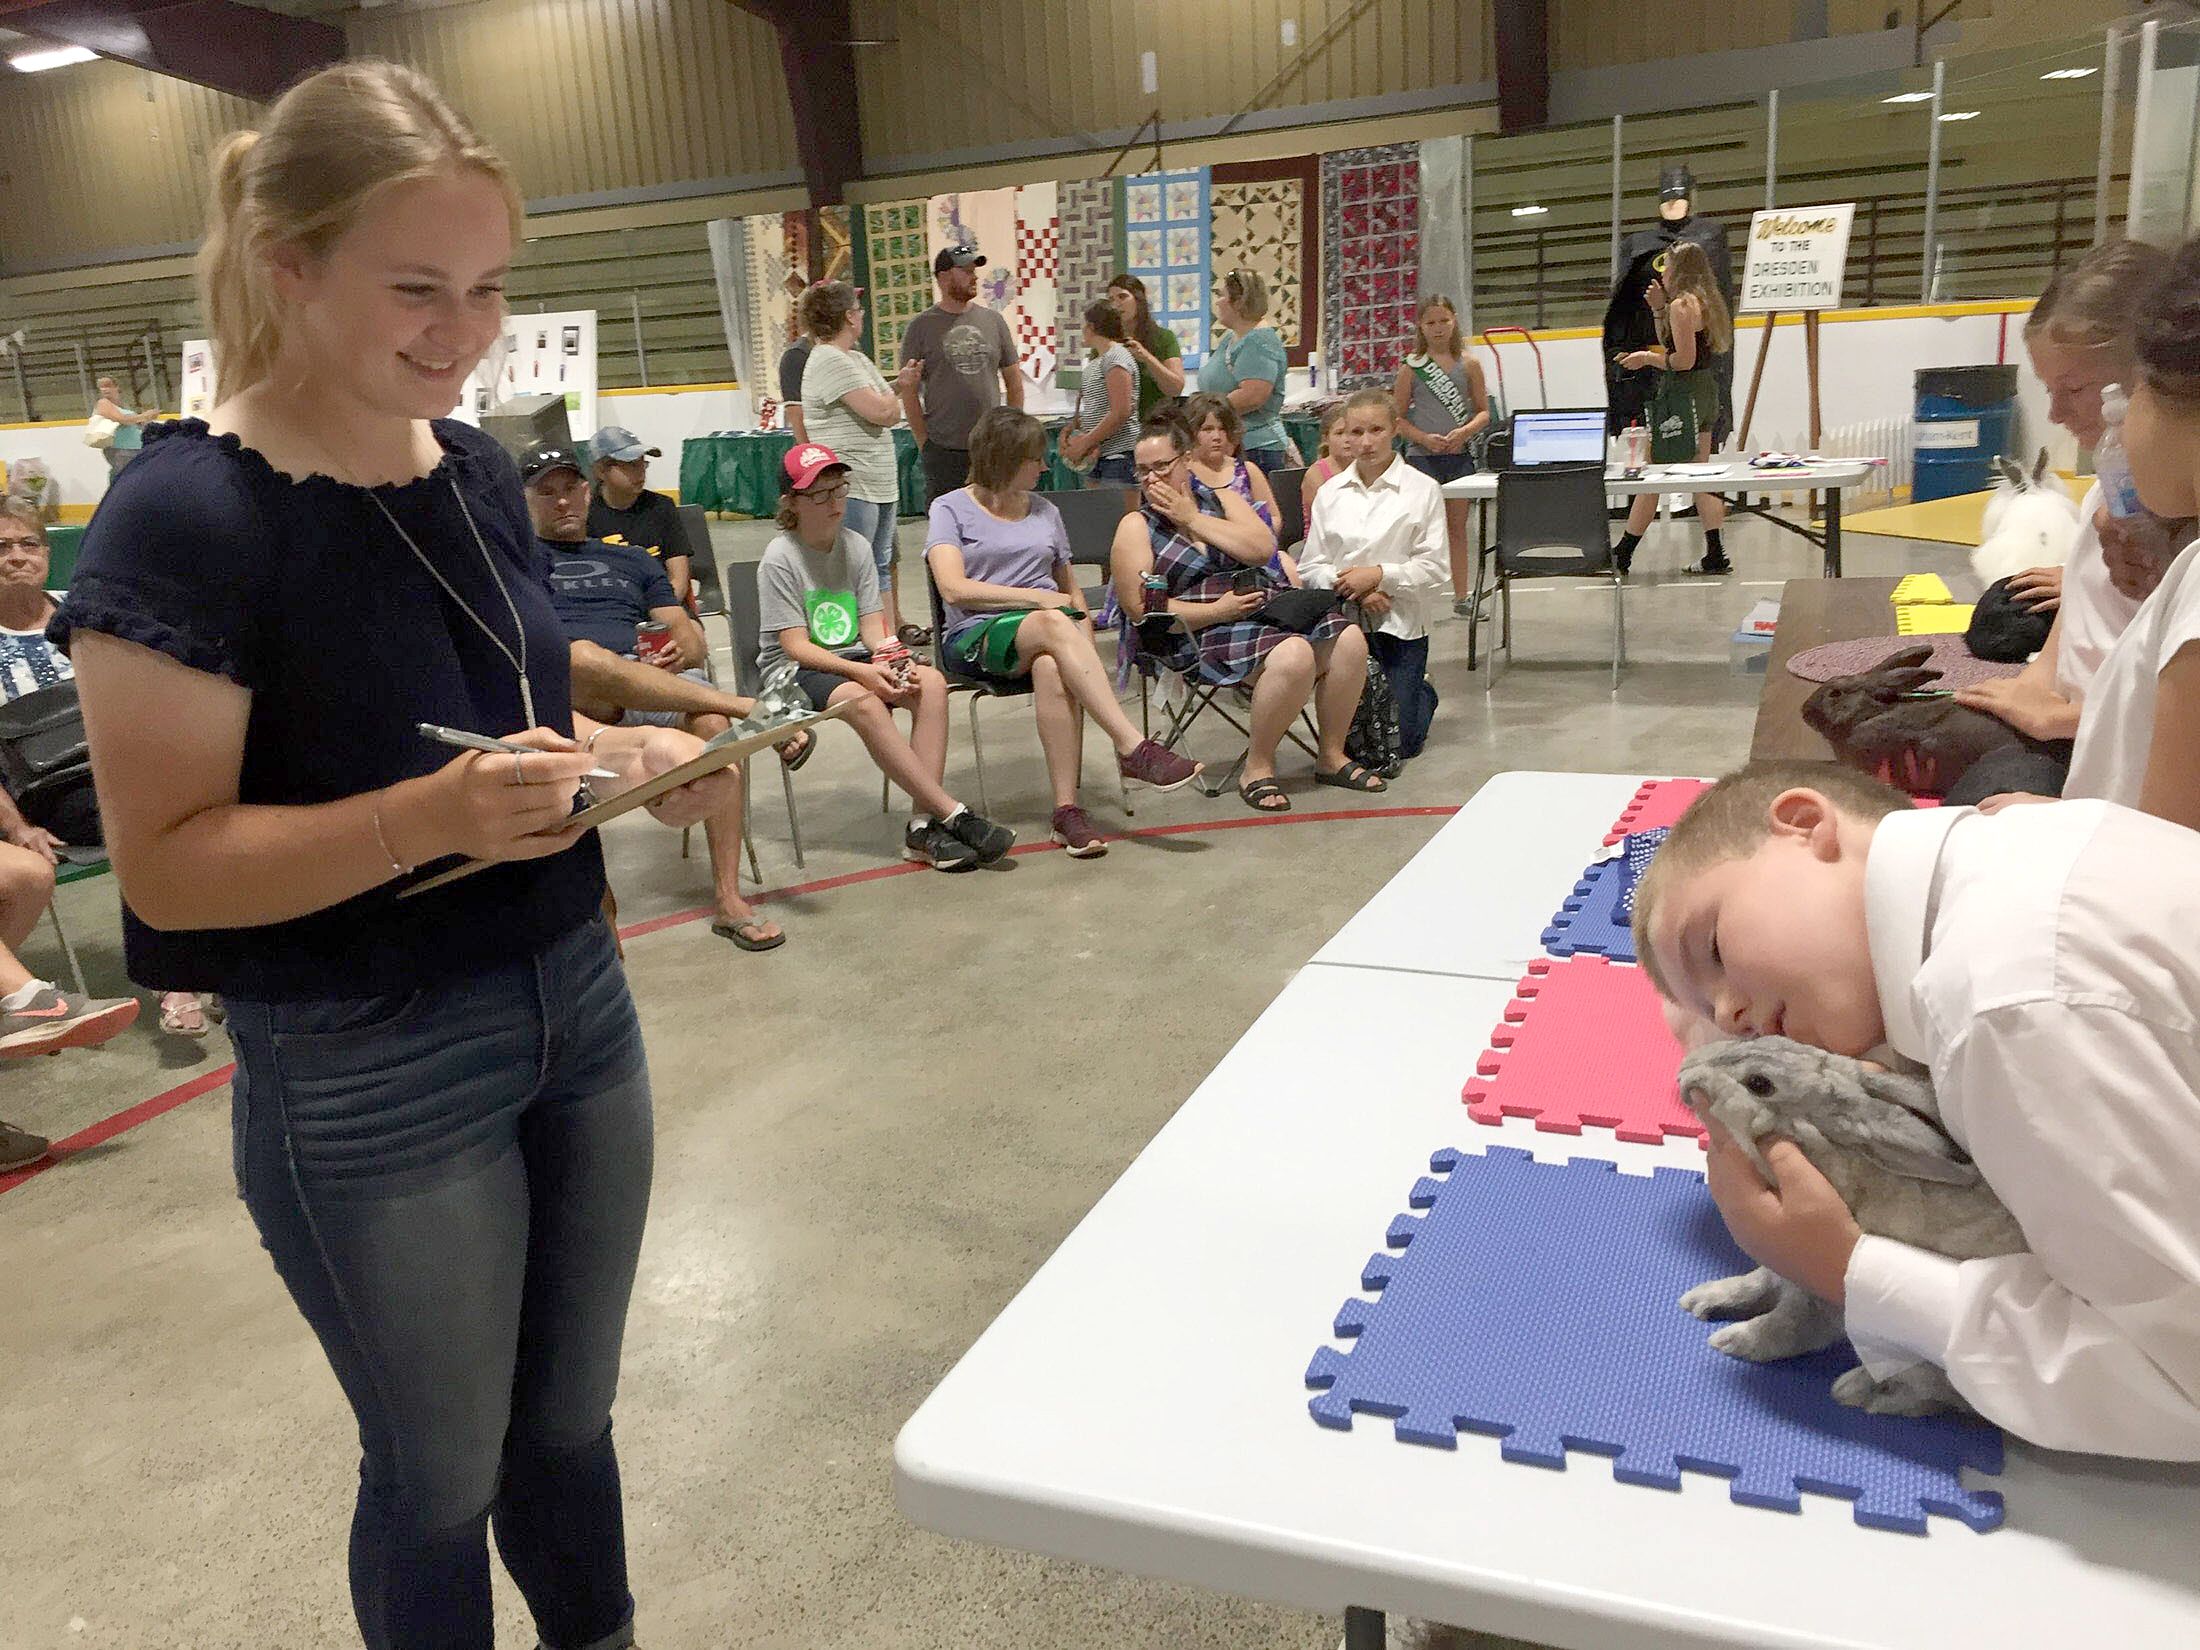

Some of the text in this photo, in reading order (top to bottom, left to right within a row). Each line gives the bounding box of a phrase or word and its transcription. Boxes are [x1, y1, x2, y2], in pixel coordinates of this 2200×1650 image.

[1757, 215, 1836, 239] Welcome
[1770, 239, 1812, 252] TO THE
[1752, 260, 1819, 277] DRESDEN
[1750, 282, 1833, 299] EXHIBITION
[1423, 361, 1467, 416] DRESDEN
[560, 577, 630, 591] KLEY
